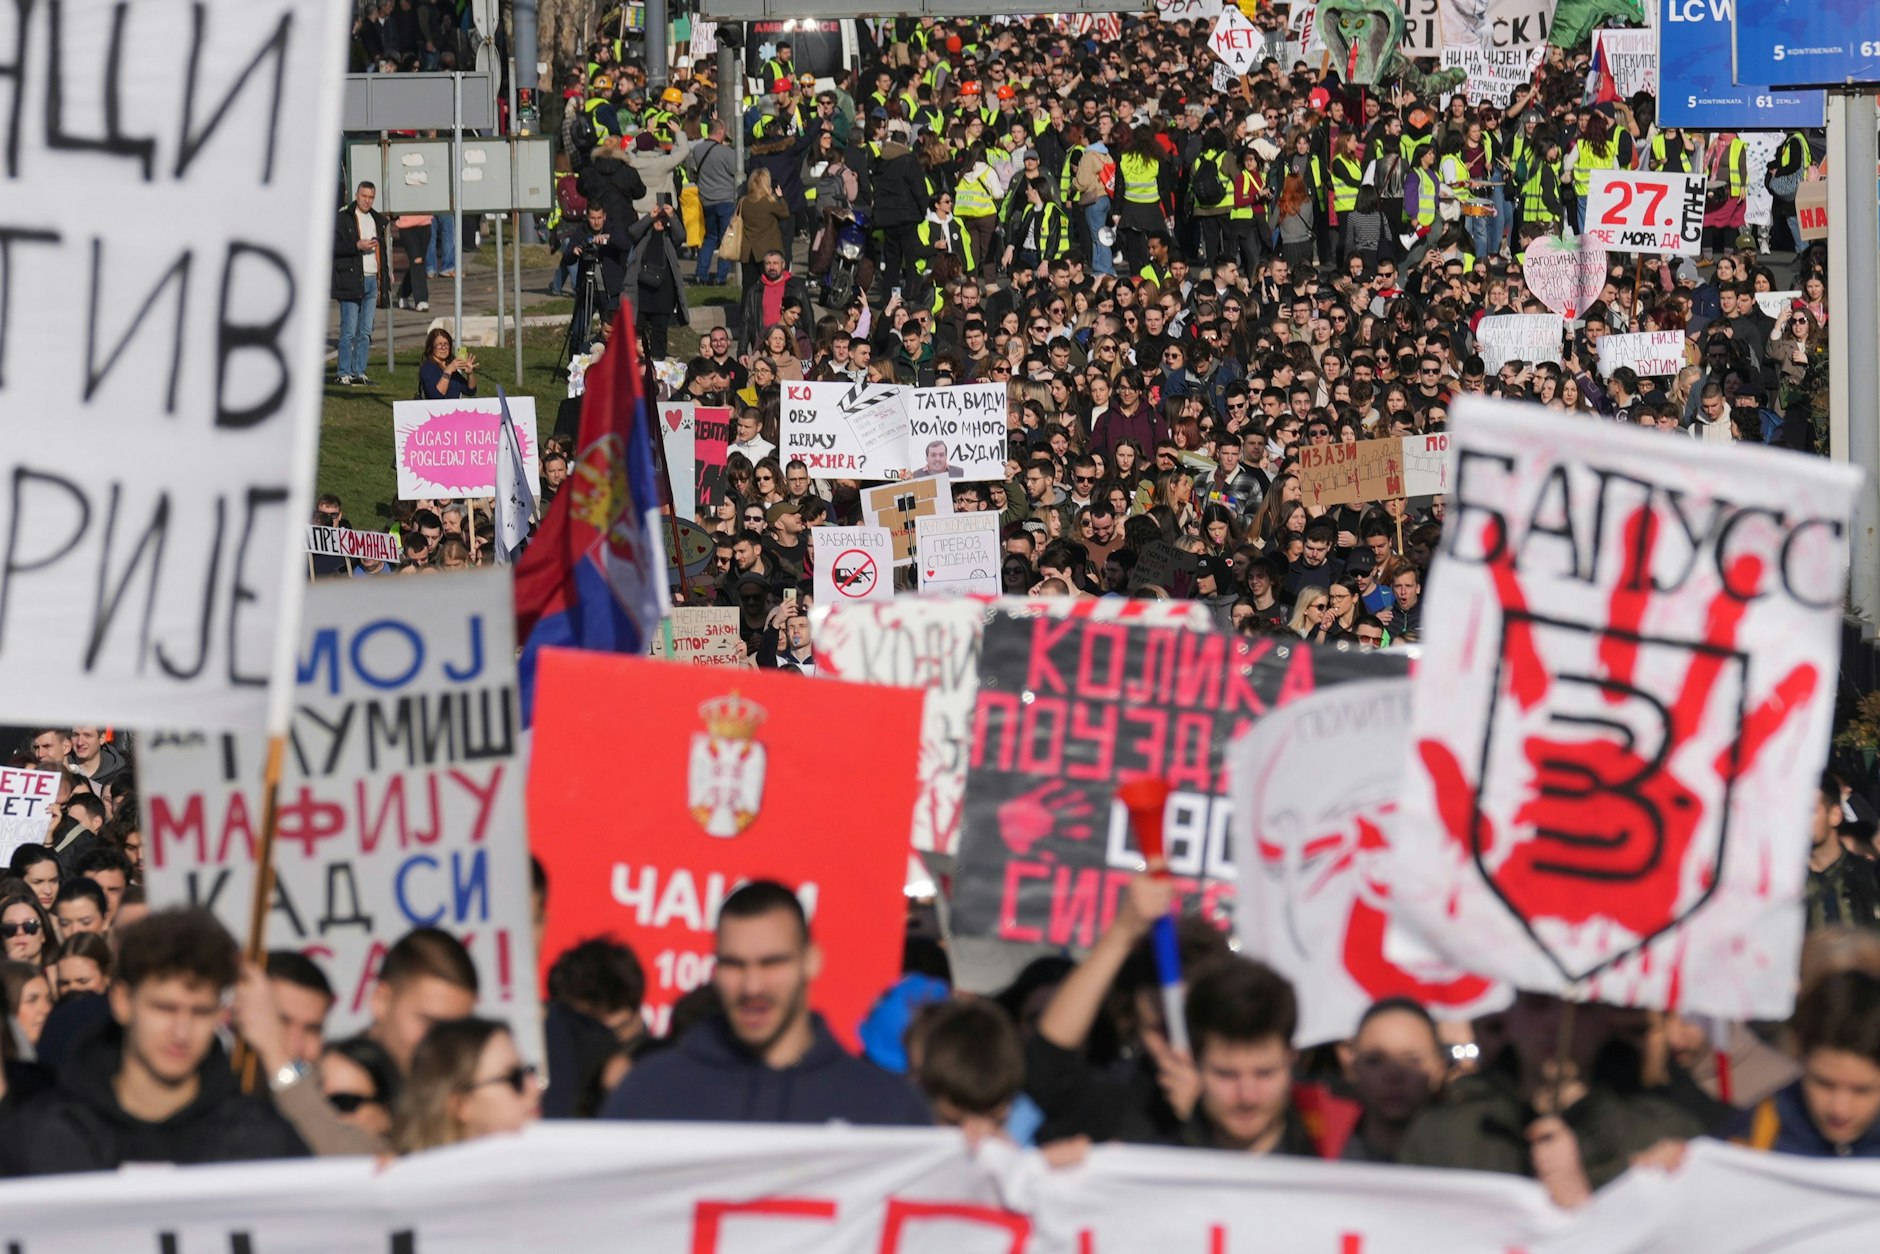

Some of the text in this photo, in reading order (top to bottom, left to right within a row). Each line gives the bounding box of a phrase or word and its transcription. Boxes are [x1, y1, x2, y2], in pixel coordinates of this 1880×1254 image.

[754, 21, 839, 33] AMBLNCE
[1773, 45, 1785, 60] 5
[1787, 47, 1842, 55] KONTINENATA
[1688, 96, 1697, 108] 5
[1756, 96, 1774, 108] 61
[1601, 181, 1673, 226] 27.
[1681, 177, 1706, 243] СТАНЕ
[1620, 231, 1657, 247] МОРА
[1660, 233, 1680, 249] ДА
[1527, 253, 1578, 268] ЈАГОДИНА
[1651, 330, 1680, 345] НИЈЕ
[787, 386, 812, 401] КО
[789, 410, 817, 424] ОВУ
[415, 430, 458, 447] UGASI
[788, 433, 837, 450] ДРАМУ
[410, 449, 465, 467] POGLEDAJ
[819, 532, 885, 549] ЗАБРАЊЕНО
[933, 535, 982, 553] ПРЕВОЗ
[927, 549, 990, 569] СТУДЕНАТА
[1026, 616, 1316, 716] КОЛИКА
[0, 796, 42, 817] ЕТ
[395, 847, 489, 926] СИ
